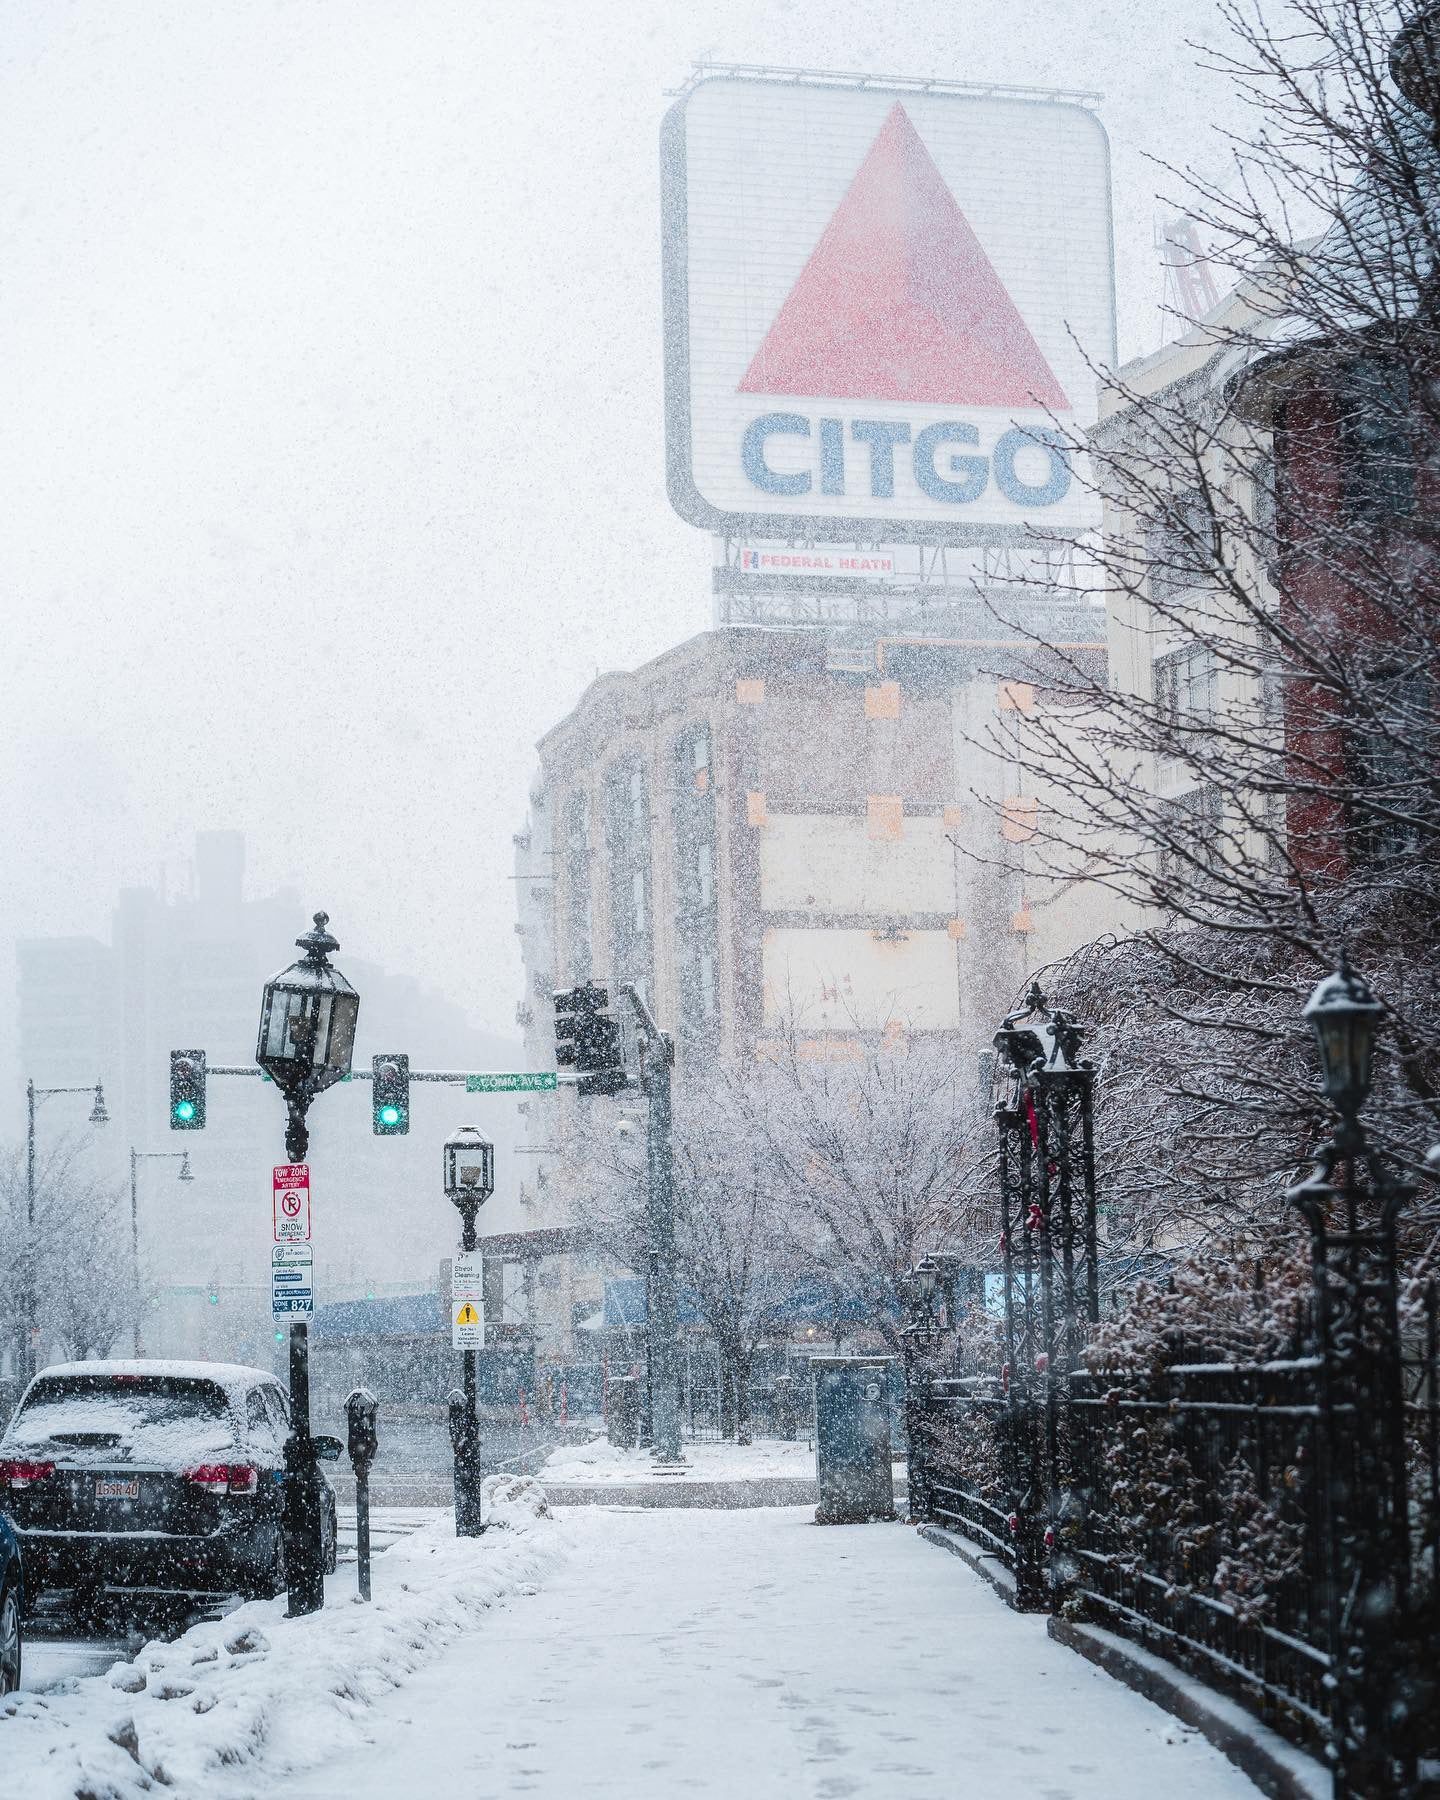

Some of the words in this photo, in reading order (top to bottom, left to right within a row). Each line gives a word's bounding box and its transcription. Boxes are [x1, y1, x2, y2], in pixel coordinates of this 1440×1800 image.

[741, 412, 1072, 507] CITGO
[761, 554, 833, 569] FEDERAL
[839, 558, 892, 571] HEATH
[480, 1077, 517, 1087] COMM
[521, 1076, 542, 1086] AVE
[274, 1168, 289, 1178] TOW
[291, 1166, 308, 1177] ZONE
[281, 1223, 303, 1231] SNOW
[291, 1299, 312, 1311] 827
[125, 1483, 138, 1496] 40
